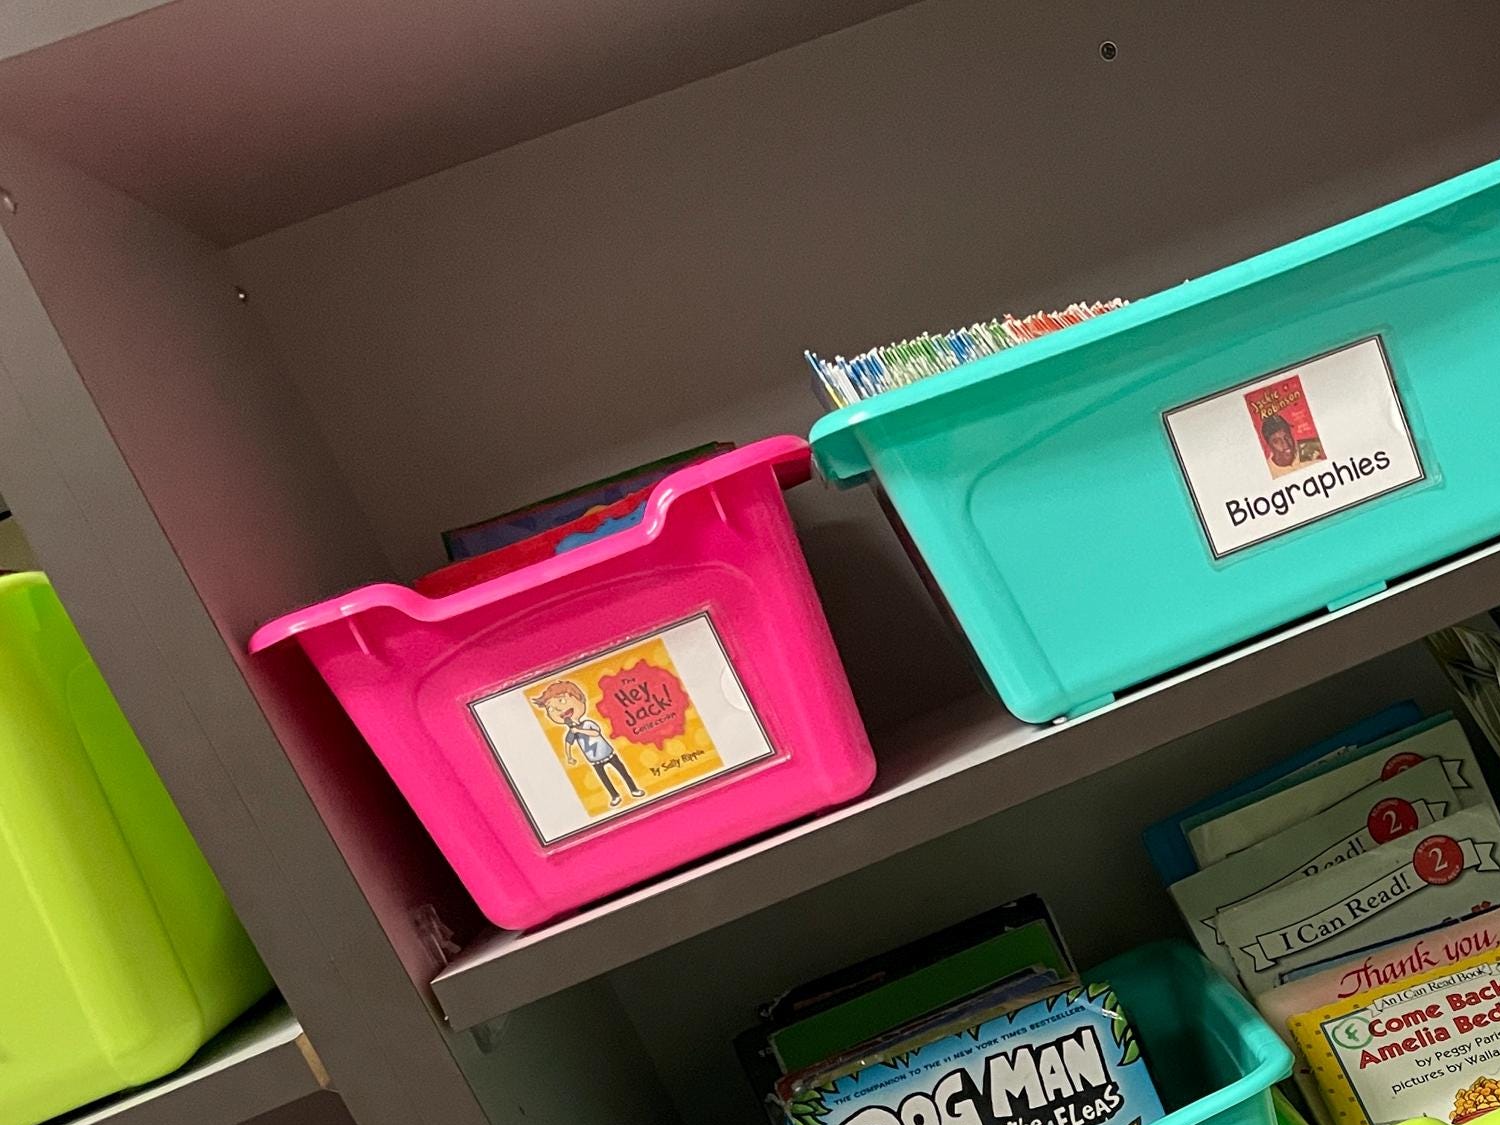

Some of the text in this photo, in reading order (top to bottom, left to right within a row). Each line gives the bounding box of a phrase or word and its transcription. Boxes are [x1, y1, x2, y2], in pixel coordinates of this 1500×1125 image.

[1261, 391, 1301, 419] Robinson
[1226, 451, 1390, 526] Biographies
[614, 681, 651, 708] Hey
[625, 683, 673, 727] Jack!
[1382, 810, 1403, 834] 2
[1279, 932, 1293, 951] I
[1297, 911, 1346, 946] Can
[1351, 873, 1412, 920] Read!
[1428, 847, 1449, 872] 2
[1337, 928, 1500, 999] Thank you,
[1380, 993, 1397, 1009] An
[1404, 986, 1427, 1002] Can
[1427, 976, 1456, 996] Read
[1457, 966, 1488, 984] Book
[1368, 1003, 1442, 1038] Come
[833, 1094, 851, 1106] THE
[853, 1074, 907, 1098] COMPANION
[908, 1068, 921, 1078] TO
[923, 1061, 942, 1072] THE
[953, 1048, 974, 1062] NEW
[975, 1037, 999, 1052] YORK
[1000, 1027, 1028, 1042] TIMES
[1029, 1005, 1087, 1031] BESTSELLERS
[1359, 1025, 1451, 1070] Amelia
[1415, 1056, 1432, 1071] by
[1435, 1041, 1472, 1064] Peggy
[987, 1026, 1110, 1119] MAN
[1391, 1068, 1445, 1095] pictures
[1446, 1060, 1463, 1074] by
